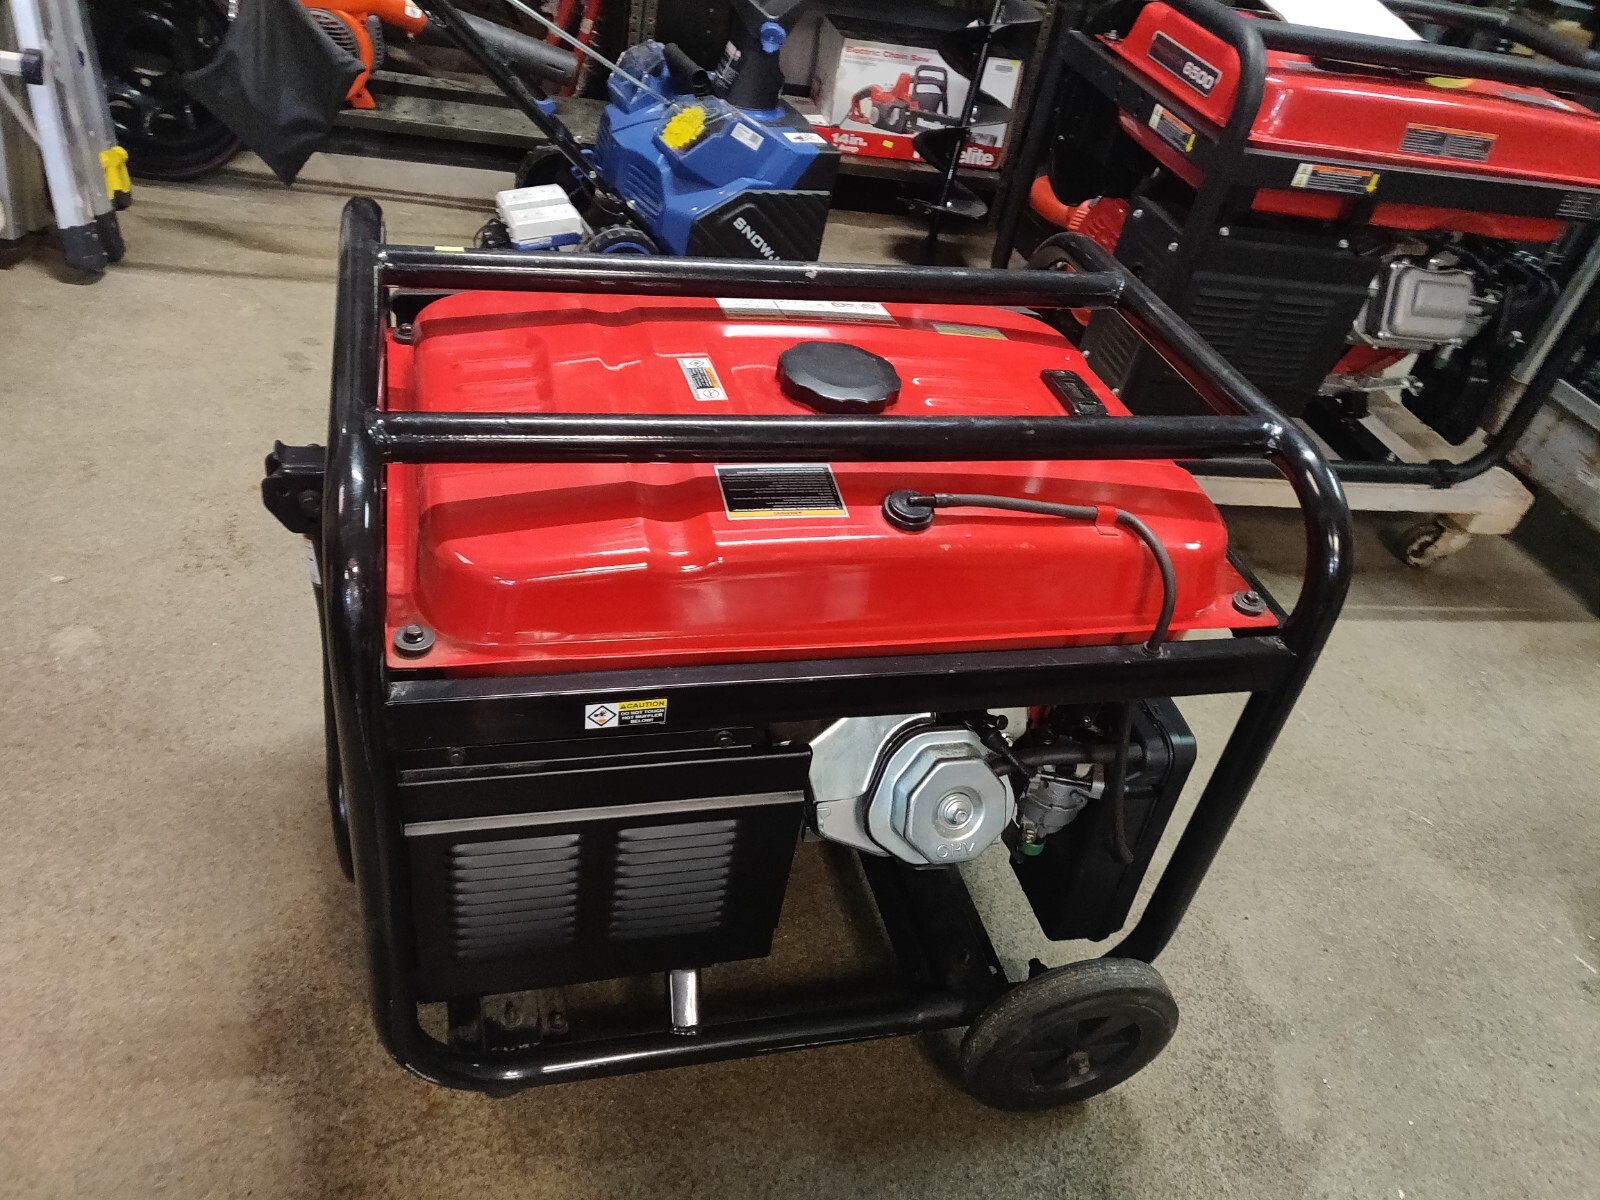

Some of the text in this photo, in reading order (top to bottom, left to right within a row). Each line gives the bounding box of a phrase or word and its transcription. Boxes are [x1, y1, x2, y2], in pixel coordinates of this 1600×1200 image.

[846, 46, 880, 56] Electric
[883, 51, 908, 60] Chain
[1182, 61, 1215, 90] 6500
[733, 217, 780, 260] SNOW
[626, 700, 664, 708] CAUTION
[936, 842, 976, 858] OHV
